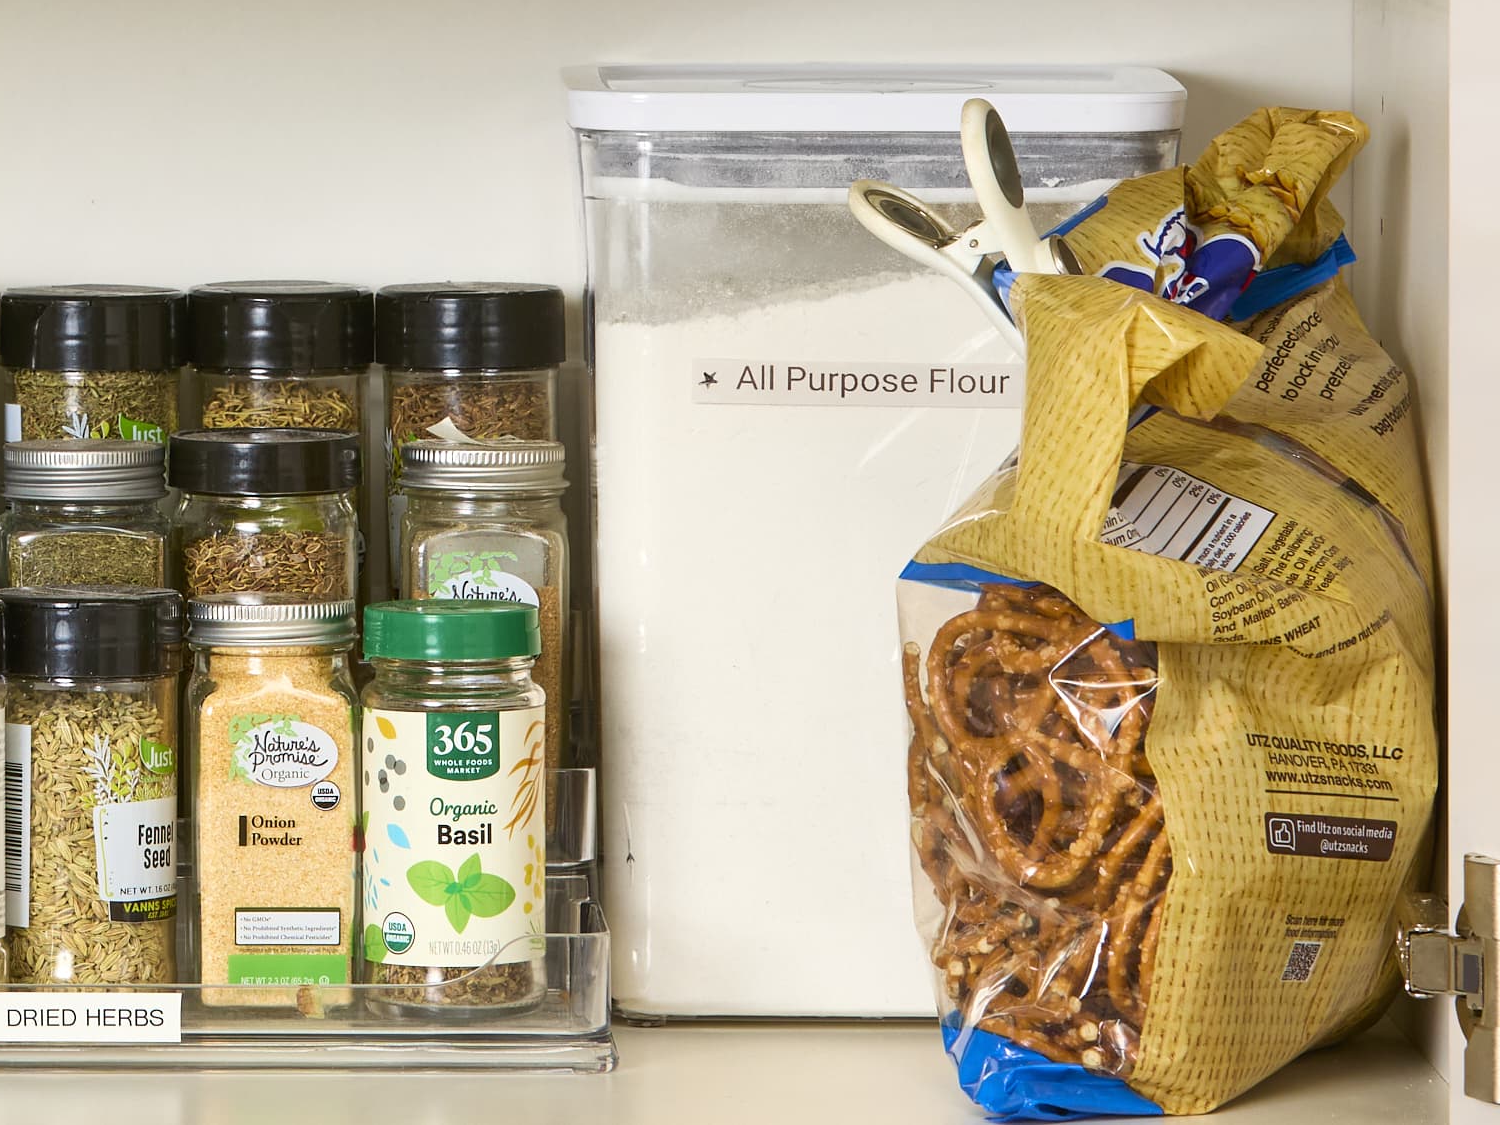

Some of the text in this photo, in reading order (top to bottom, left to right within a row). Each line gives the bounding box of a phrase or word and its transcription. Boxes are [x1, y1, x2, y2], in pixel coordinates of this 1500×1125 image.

[737, 364, 1009, 398] All Purpose Flour
[254, 731, 320, 754] Nature's
[433, 721, 492, 755] 365
[1246, 733, 1403, 760] UTZ QUALITY FOODS, LLC
[249, 751, 329, 776] Promise
[434, 759, 462, 767] WHOLE
[1268, 752, 1379, 774] HANOVER, PA 17331
[261, 768, 310, 782] Organic
[1265, 770, 1393, 791] www.utzsnacks.com
[430, 797, 498, 822] Organic
[251, 815, 296, 829] Onion
[1297, 820, 1393, 839] Find Utz on social media
[138, 822, 174, 846] Fennel
[251, 833, 302, 846] Powder
[437, 823, 492, 845] Basil
[1320, 838, 1368, 854] @utzsnacks
[144, 846, 171, 869] Seed
[7, 1007, 164, 1027] DRIED HERBS
